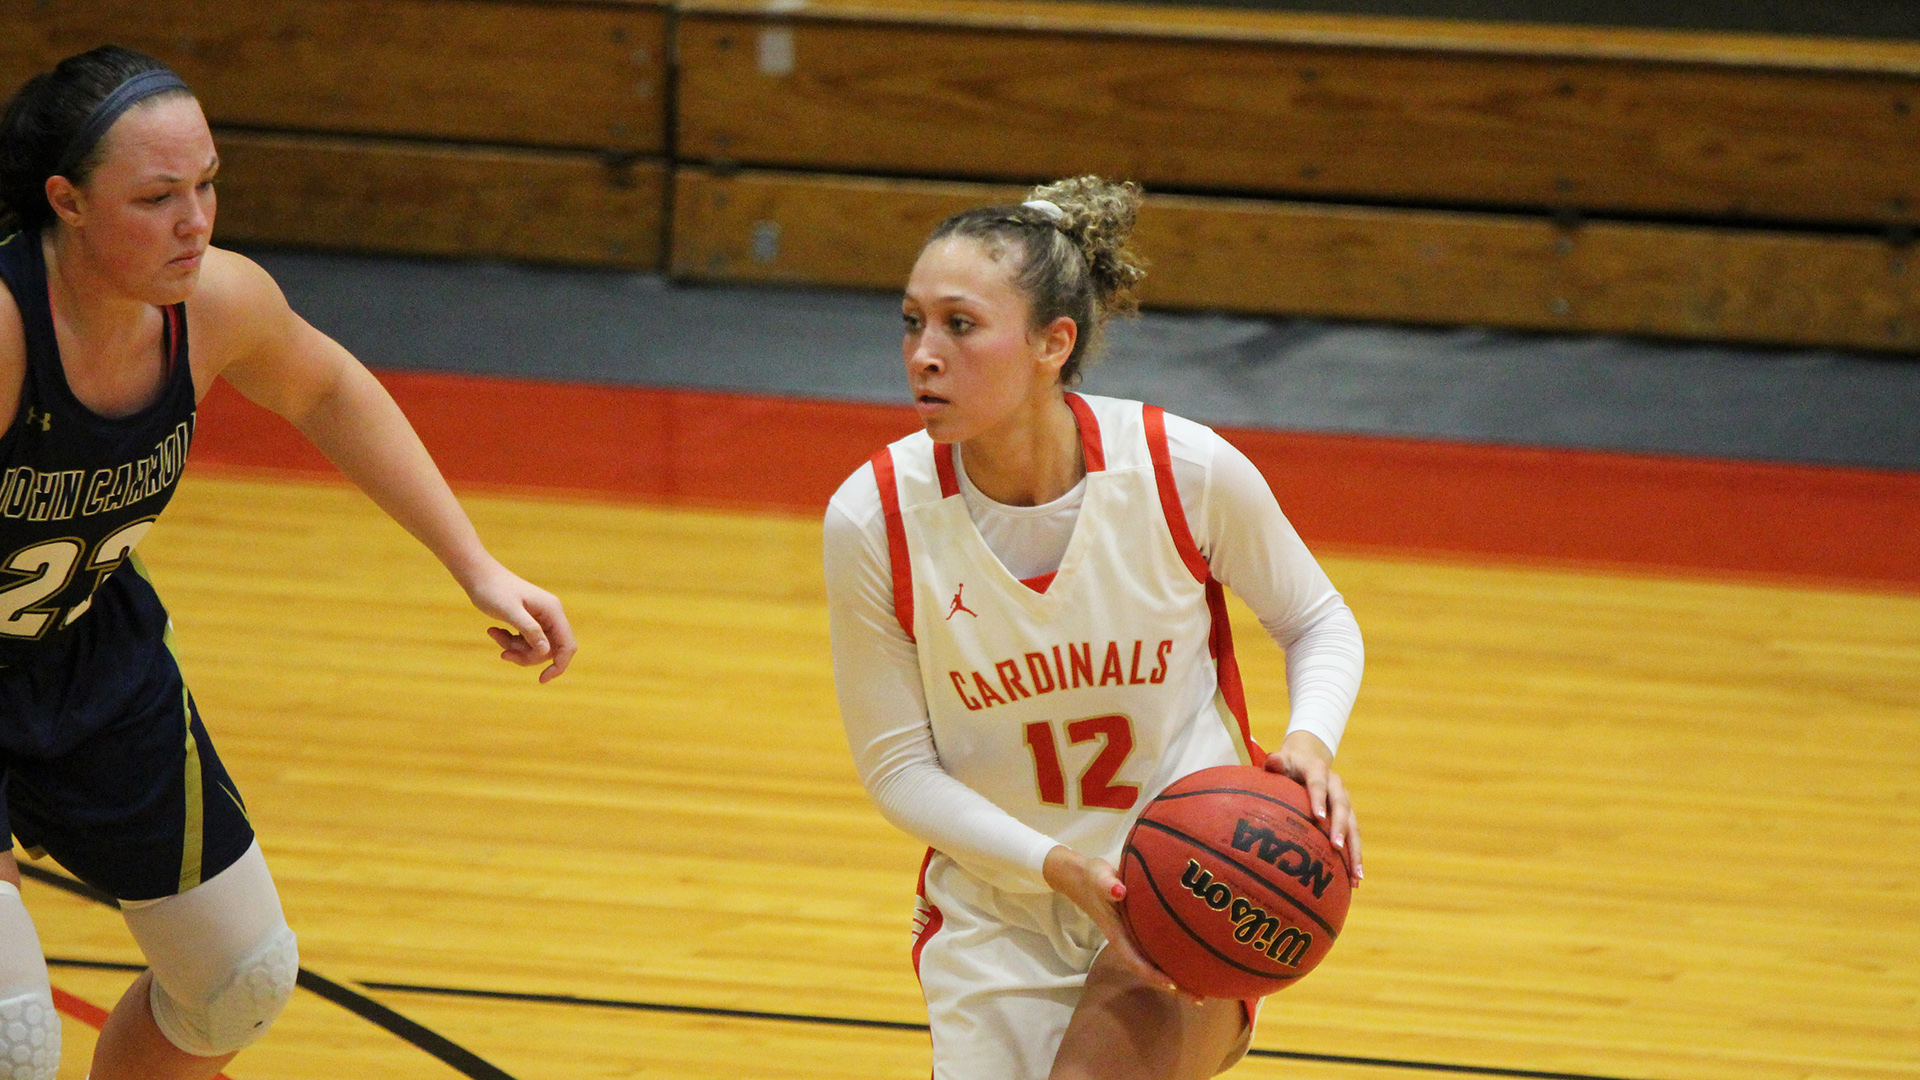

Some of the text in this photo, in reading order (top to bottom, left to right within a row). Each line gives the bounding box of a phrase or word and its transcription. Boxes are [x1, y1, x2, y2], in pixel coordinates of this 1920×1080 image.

[82, 411, 197, 516] CARROL
[949, 639, 1174, 711] CARDINALS
[1022, 712, 1143, 814] 12
[1231, 818, 1334, 899] NCAA
[1180, 858, 1313, 968] Wilson
